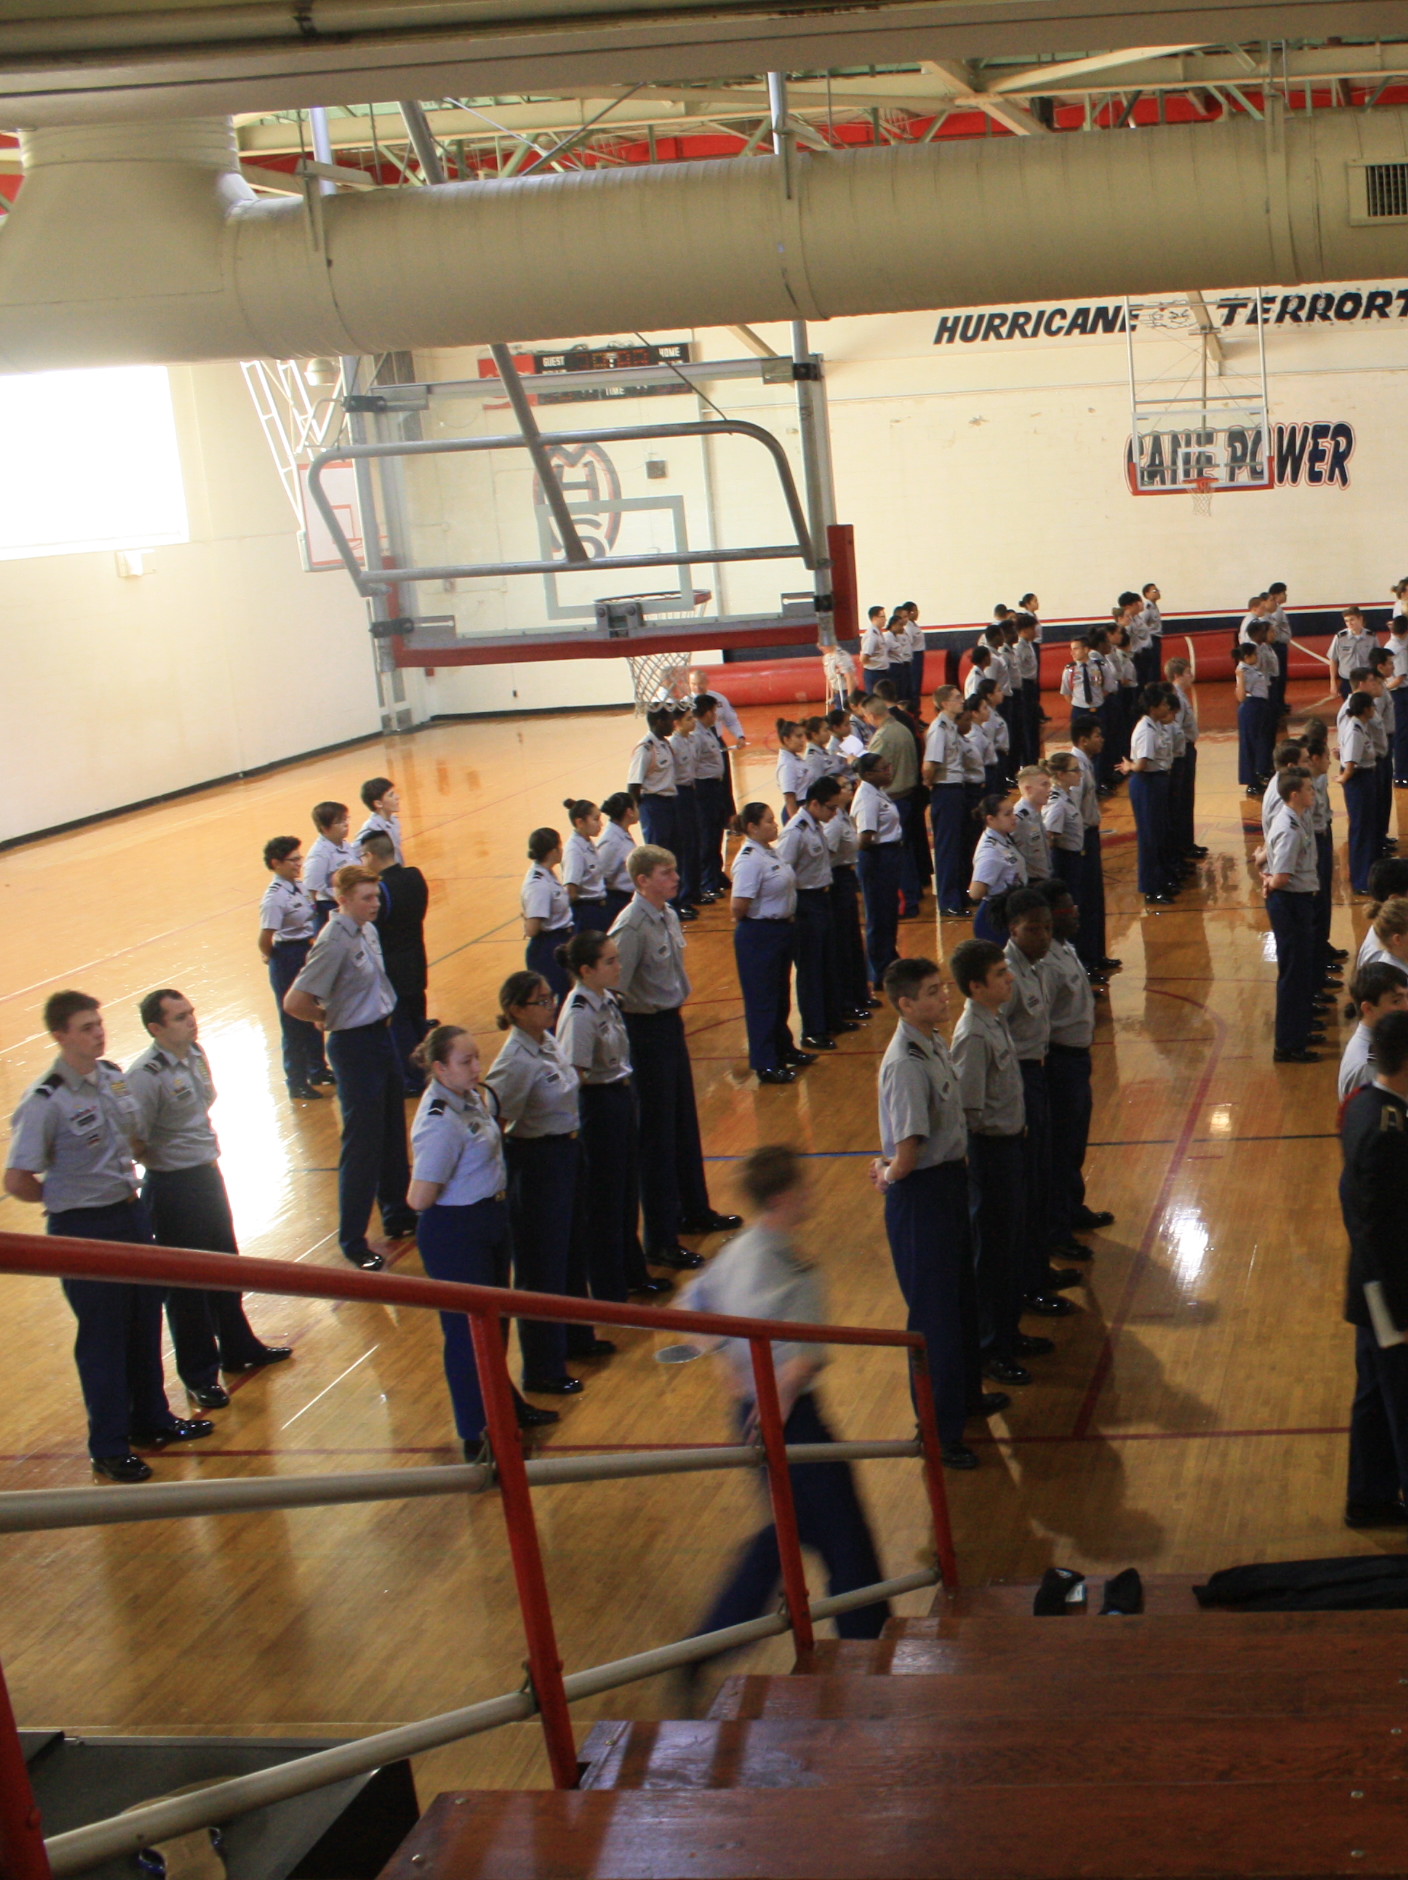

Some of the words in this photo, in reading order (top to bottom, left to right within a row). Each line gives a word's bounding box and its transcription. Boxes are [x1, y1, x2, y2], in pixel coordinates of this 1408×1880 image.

[932, 304, 1142, 345] HURRICANE
[542, 356, 566, 367] GUEST
[1224, 421, 1356, 490] POWER
